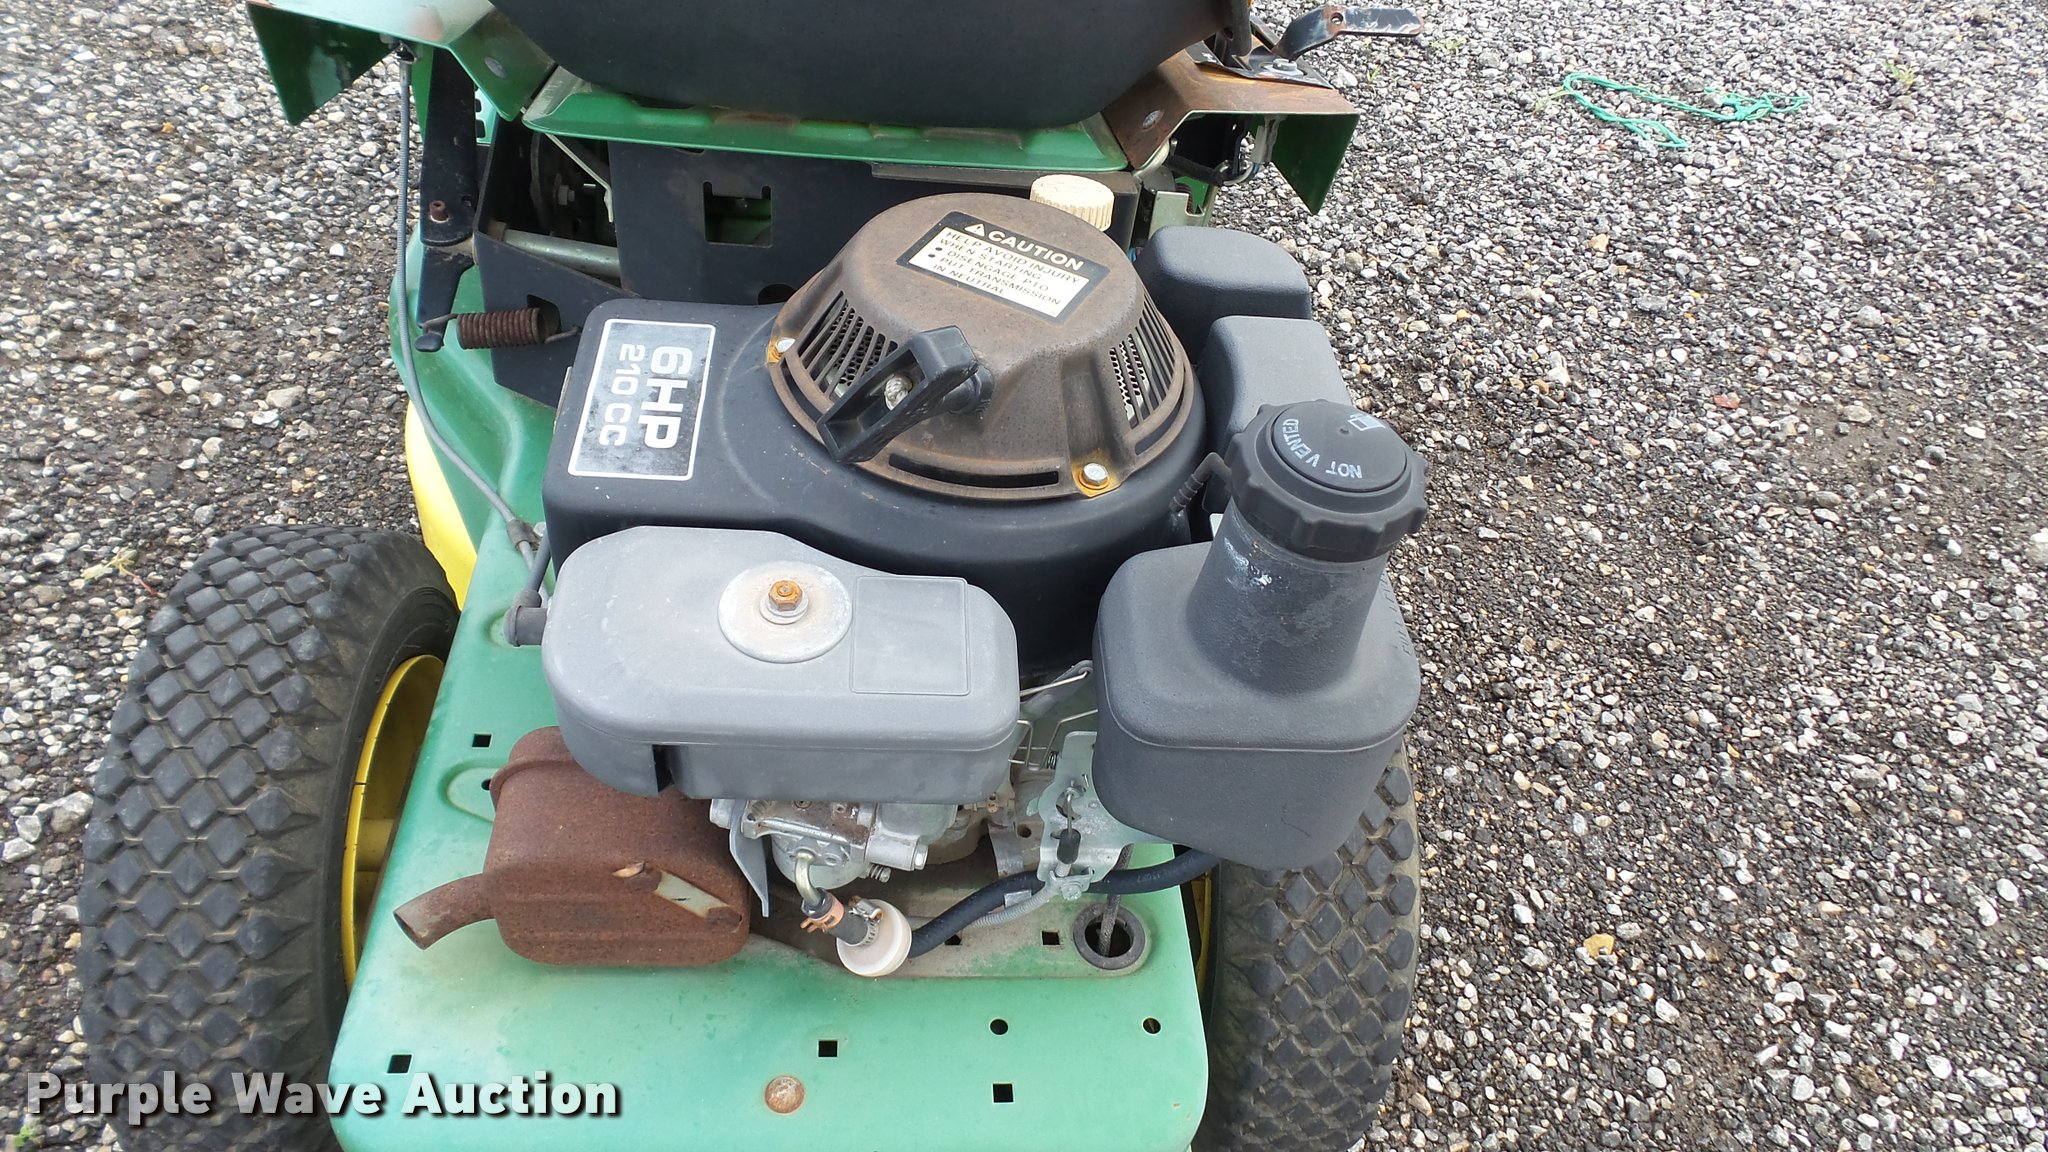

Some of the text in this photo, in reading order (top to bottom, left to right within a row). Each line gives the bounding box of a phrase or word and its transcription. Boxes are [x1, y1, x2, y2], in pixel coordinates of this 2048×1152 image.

[940, 238, 1042, 280] WHEN STARTING
[946, 232, 1080, 283] HELP AVOID INJURY
[947, 250, 1049, 292] DISENGAGE PTO
[988, 230, 1084, 271] CAUTION
[933, 264, 1005, 294] IN NEUTRAL
[940, 257, 1061, 305] PUT TRANSMISSION
[610, 343, 646, 396] 210
[638, 346, 693, 449] 6HP
[1282, 418, 1363, 479] NOT VENTED
